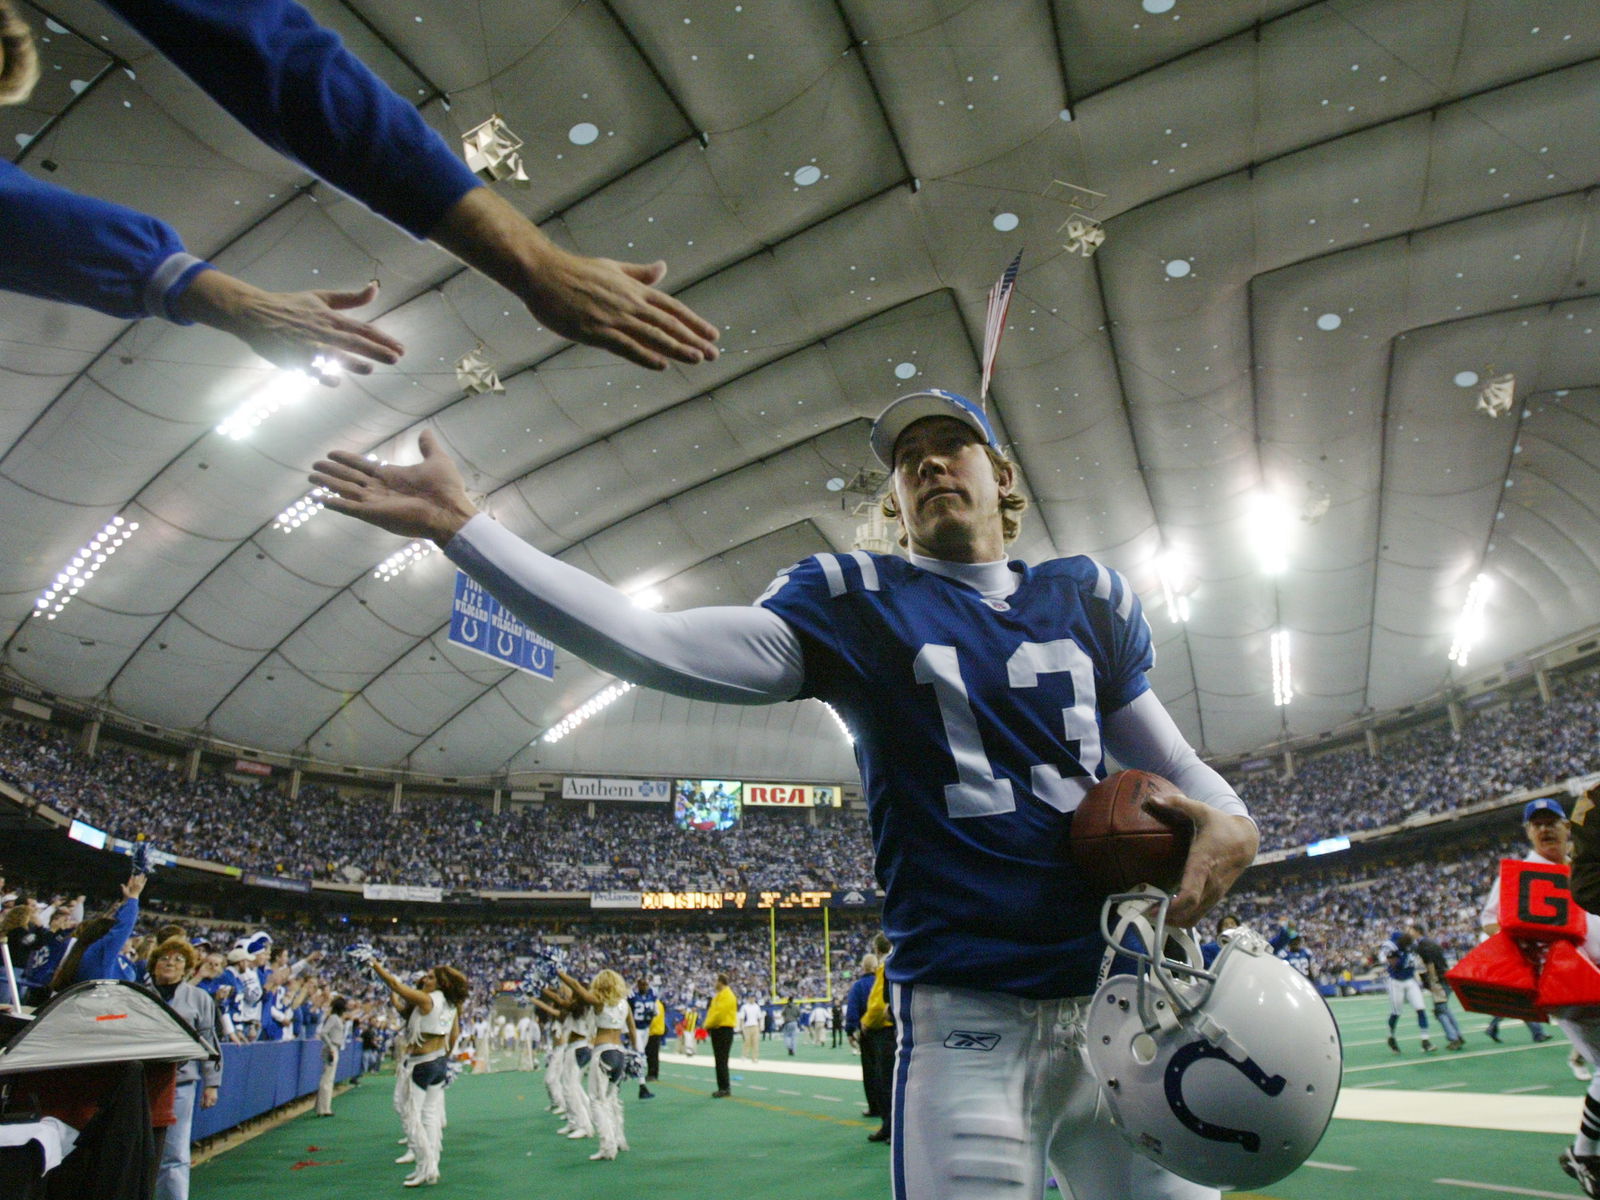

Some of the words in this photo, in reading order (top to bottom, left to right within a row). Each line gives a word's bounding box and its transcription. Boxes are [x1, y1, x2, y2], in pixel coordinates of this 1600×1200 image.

[913, 638, 1102, 819] 13
[566, 778, 634, 797] Anthem
[751, 787, 805, 804] RCA
[1518, 870, 1569, 926] G
